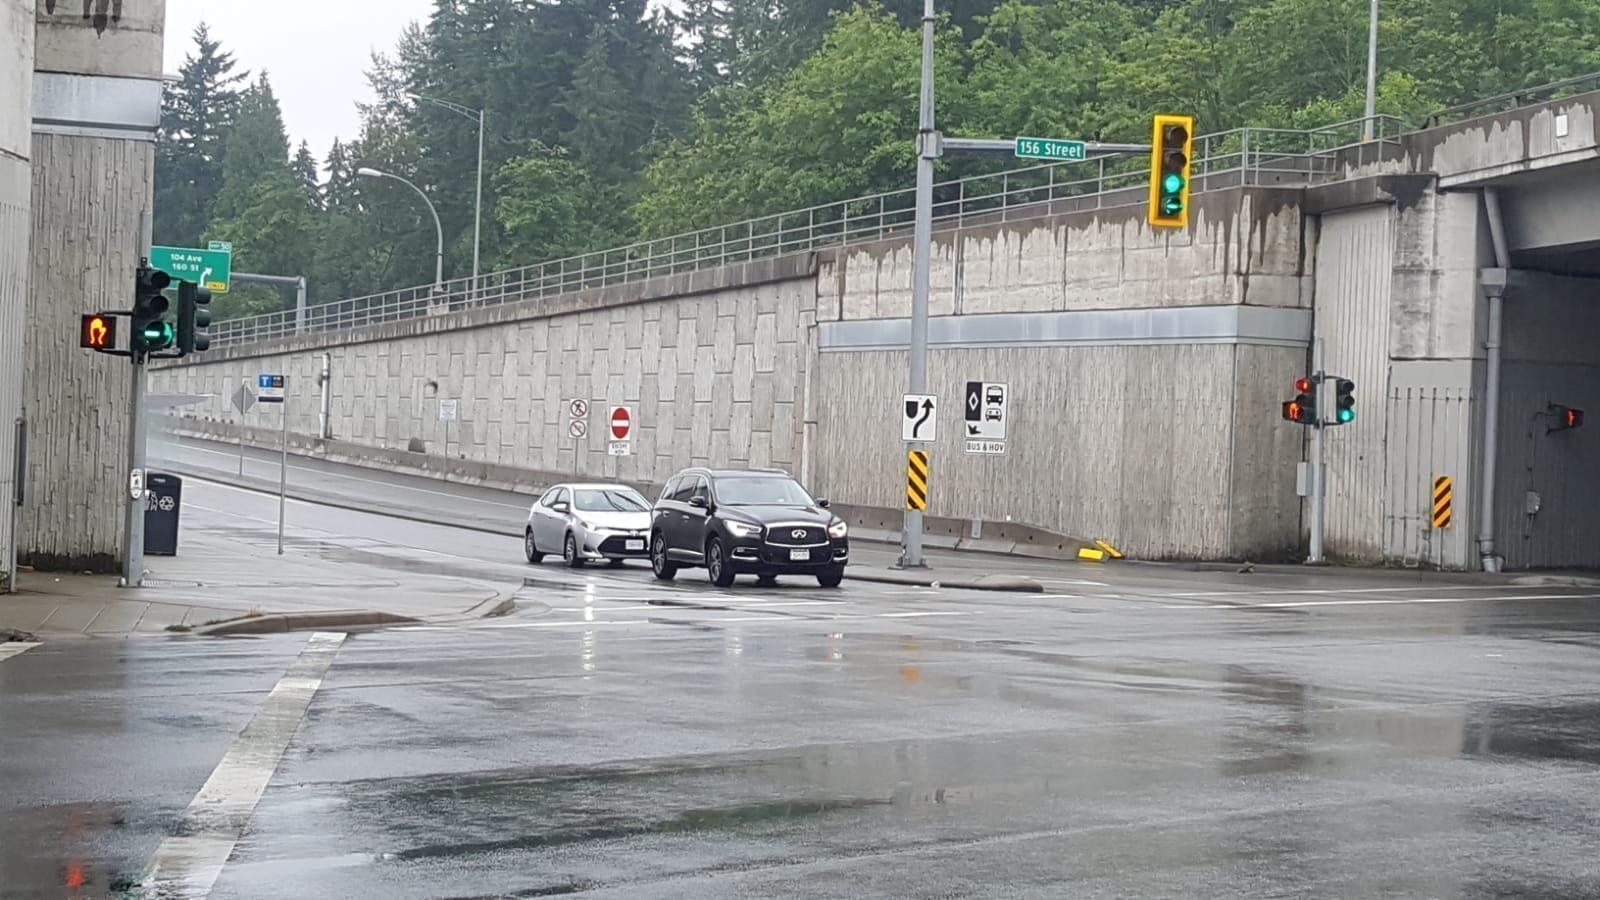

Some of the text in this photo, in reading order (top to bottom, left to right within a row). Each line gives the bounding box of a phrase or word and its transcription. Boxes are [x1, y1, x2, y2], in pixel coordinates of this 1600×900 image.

[1020, 141, 1082, 158] 156 Street
[170, 253, 203, 263] 104 Ave
[172, 263, 200, 272] 160 St
[967, 442, 981, 451] BUS
[989, 443, 1004, 451] HOV
